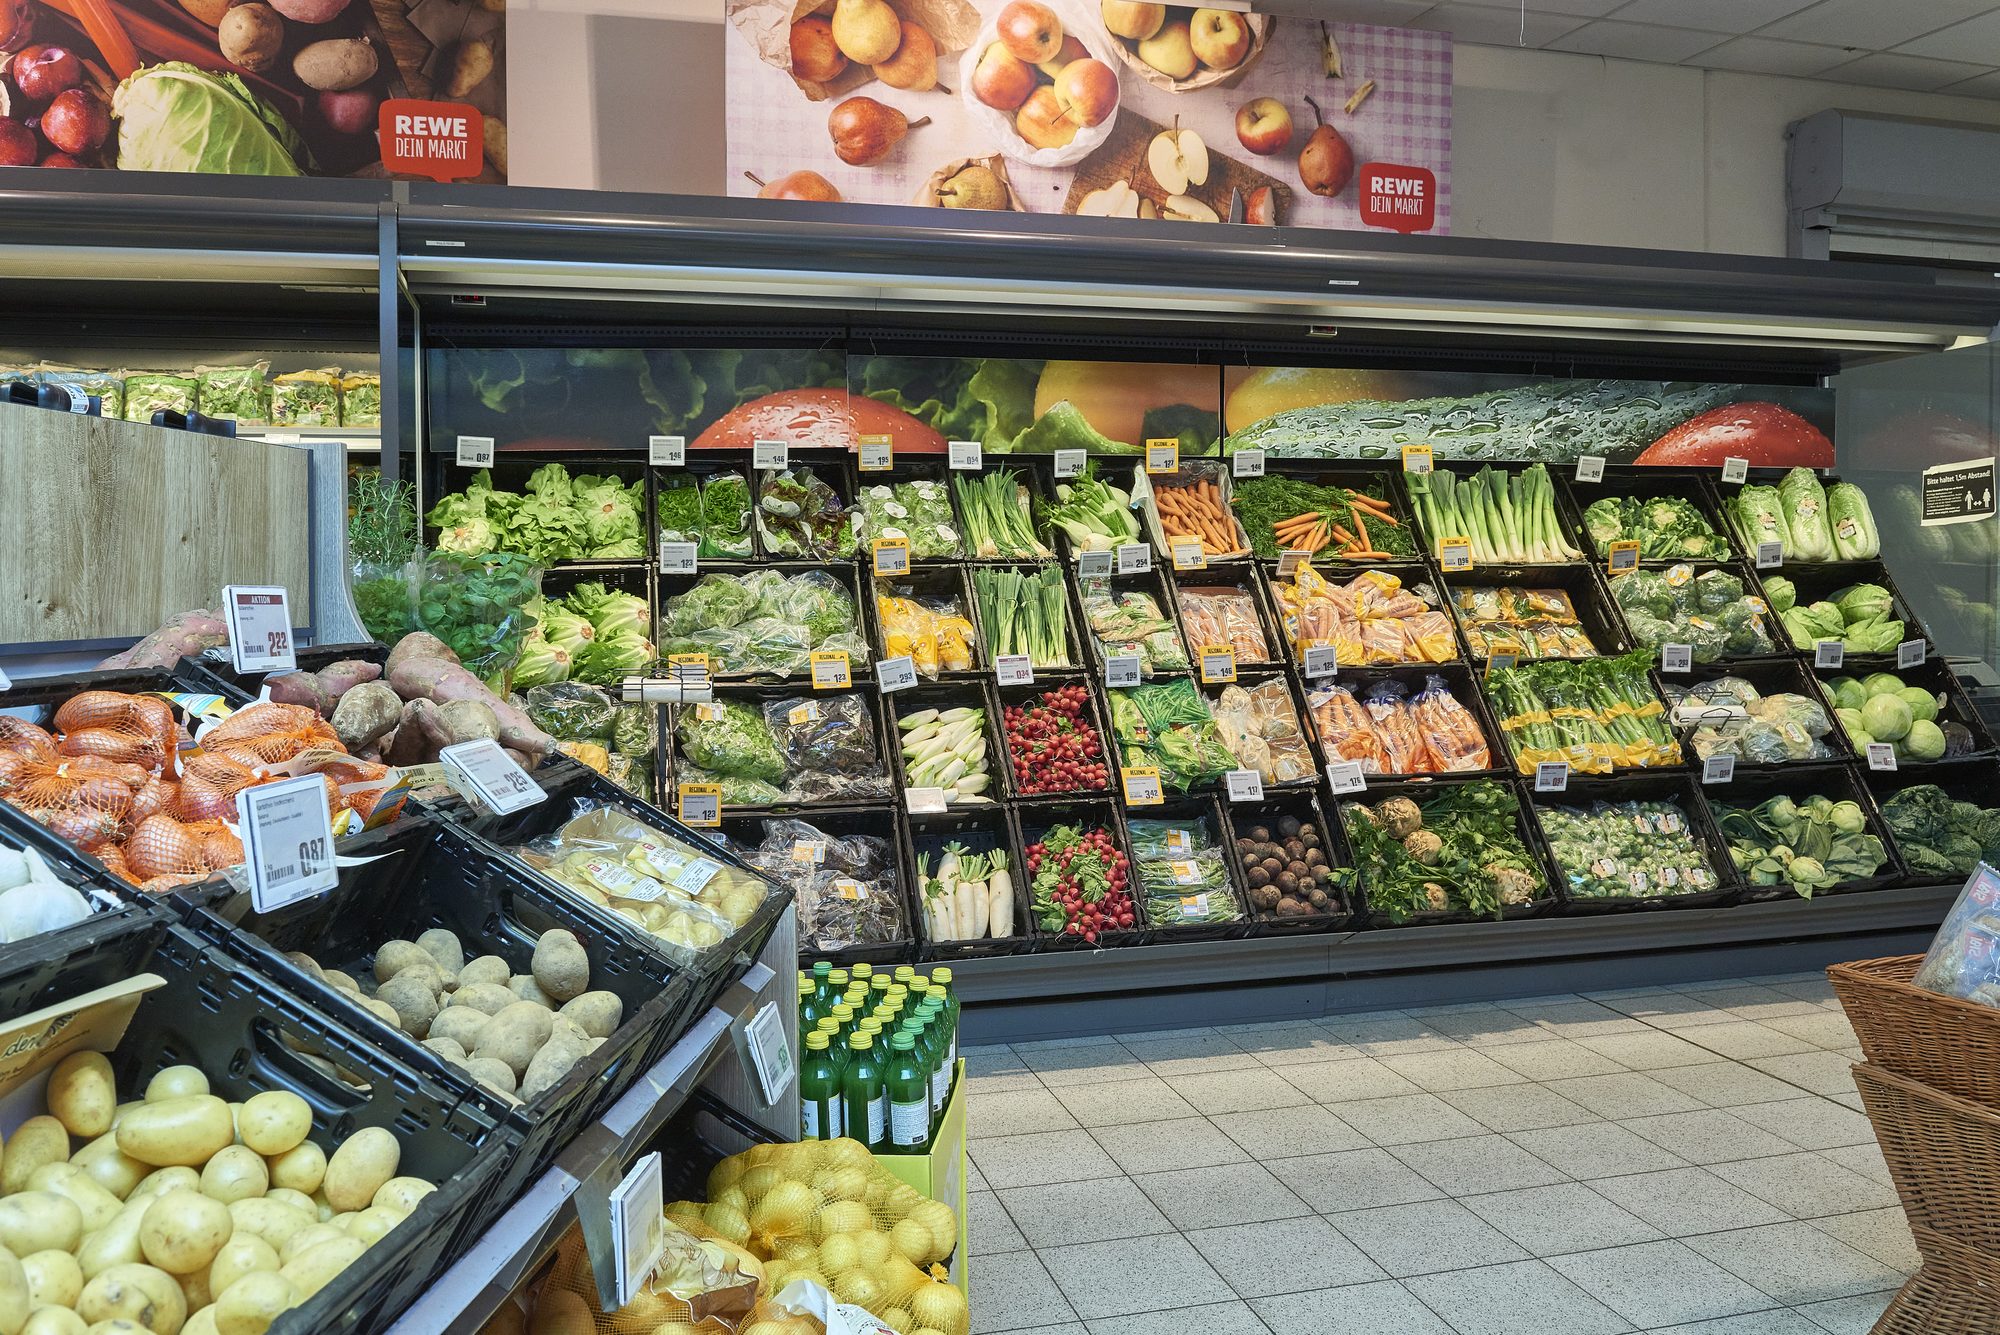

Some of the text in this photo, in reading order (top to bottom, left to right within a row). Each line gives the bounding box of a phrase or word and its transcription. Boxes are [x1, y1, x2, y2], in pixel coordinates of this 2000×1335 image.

[395, 115, 468, 138] REWE
[396, 138, 468, 160] DEIN MARKT
[1371, 176, 1424, 196] REWE
[1370, 195, 1424, 215] DEIN MARKT
[1926, 478, 1939, 486] Bitte
[1939, 476, 1955, 484] haltet
[251, 595, 271, 604] AKTION
[267, 631, 288, 657] 2.22
[702, 810, 716, 820] 1.23
[298, 837, 325, 878] 0.87
